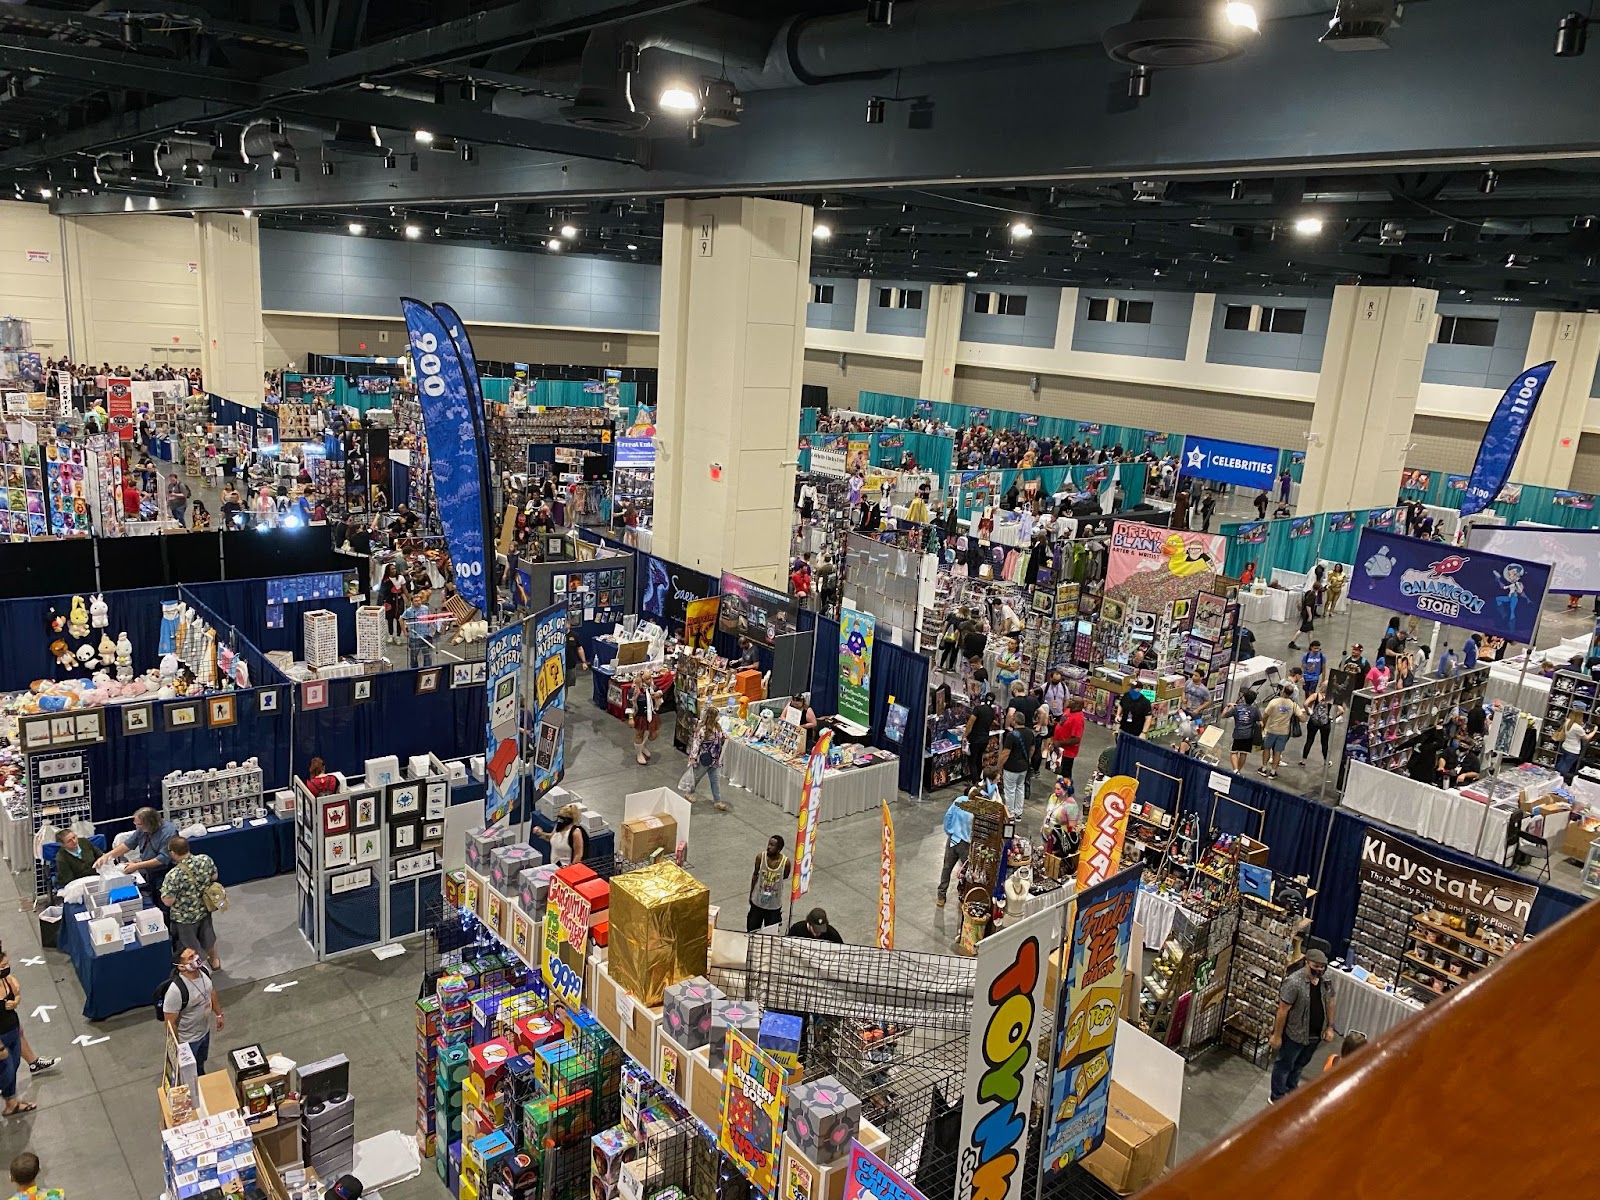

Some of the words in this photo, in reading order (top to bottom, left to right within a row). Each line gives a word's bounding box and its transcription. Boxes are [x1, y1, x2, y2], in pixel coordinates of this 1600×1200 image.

[702, 224, 708, 238] N
[702, 242, 707, 254] 9
[416, 333, 444, 396] 900
[1511, 376, 1538, 414] 1100
[1212, 455, 1273, 474] CELEBRITIES
[1472, 486, 1489, 499] 1100
[1114, 534, 1161, 554] BLANK
[1118, 524, 1161, 540] DREW
[1112, 547, 1130, 555] ARTER
[1138, 552, 1160, 560] WRITIST
[456, 561, 482, 578] 900
[1400, 581, 1485, 614] GALAXYCON
[1418, 597, 1458, 617] STORE
[537, 619, 554, 642] BOX
[556, 618, 566, 629] OF
[490, 636, 508, 660] BOX
[511, 634, 521, 647] OF
[537, 632, 566, 656] MYSTERY
[490, 650, 521, 675] MYSTERY
[548, 876, 591, 927] GARGANTUAN
[1370, 871, 1384, 881] The
[1415, 890, 1446, 909] Painting
[1448, 904, 1464, 914] and
[1490, 917, 1513, 932] Place
[560, 910, 587, 938] MYSTERY
[1078, 894, 1131, 944] Funko
[569, 934, 582, 953] BOX
[1087, 927, 1119, 969] 12
[1081, 956, 1118, 990] PACK
[1089, 1005, 1116, 1030] POP!
[732, 1040, 779, 1095] PUZZLE
[770, 1053, 790, 1064] llout
[733, 1062, 775, 1105] MYSTERY
[743, 1085, 763, 1110] BOX
